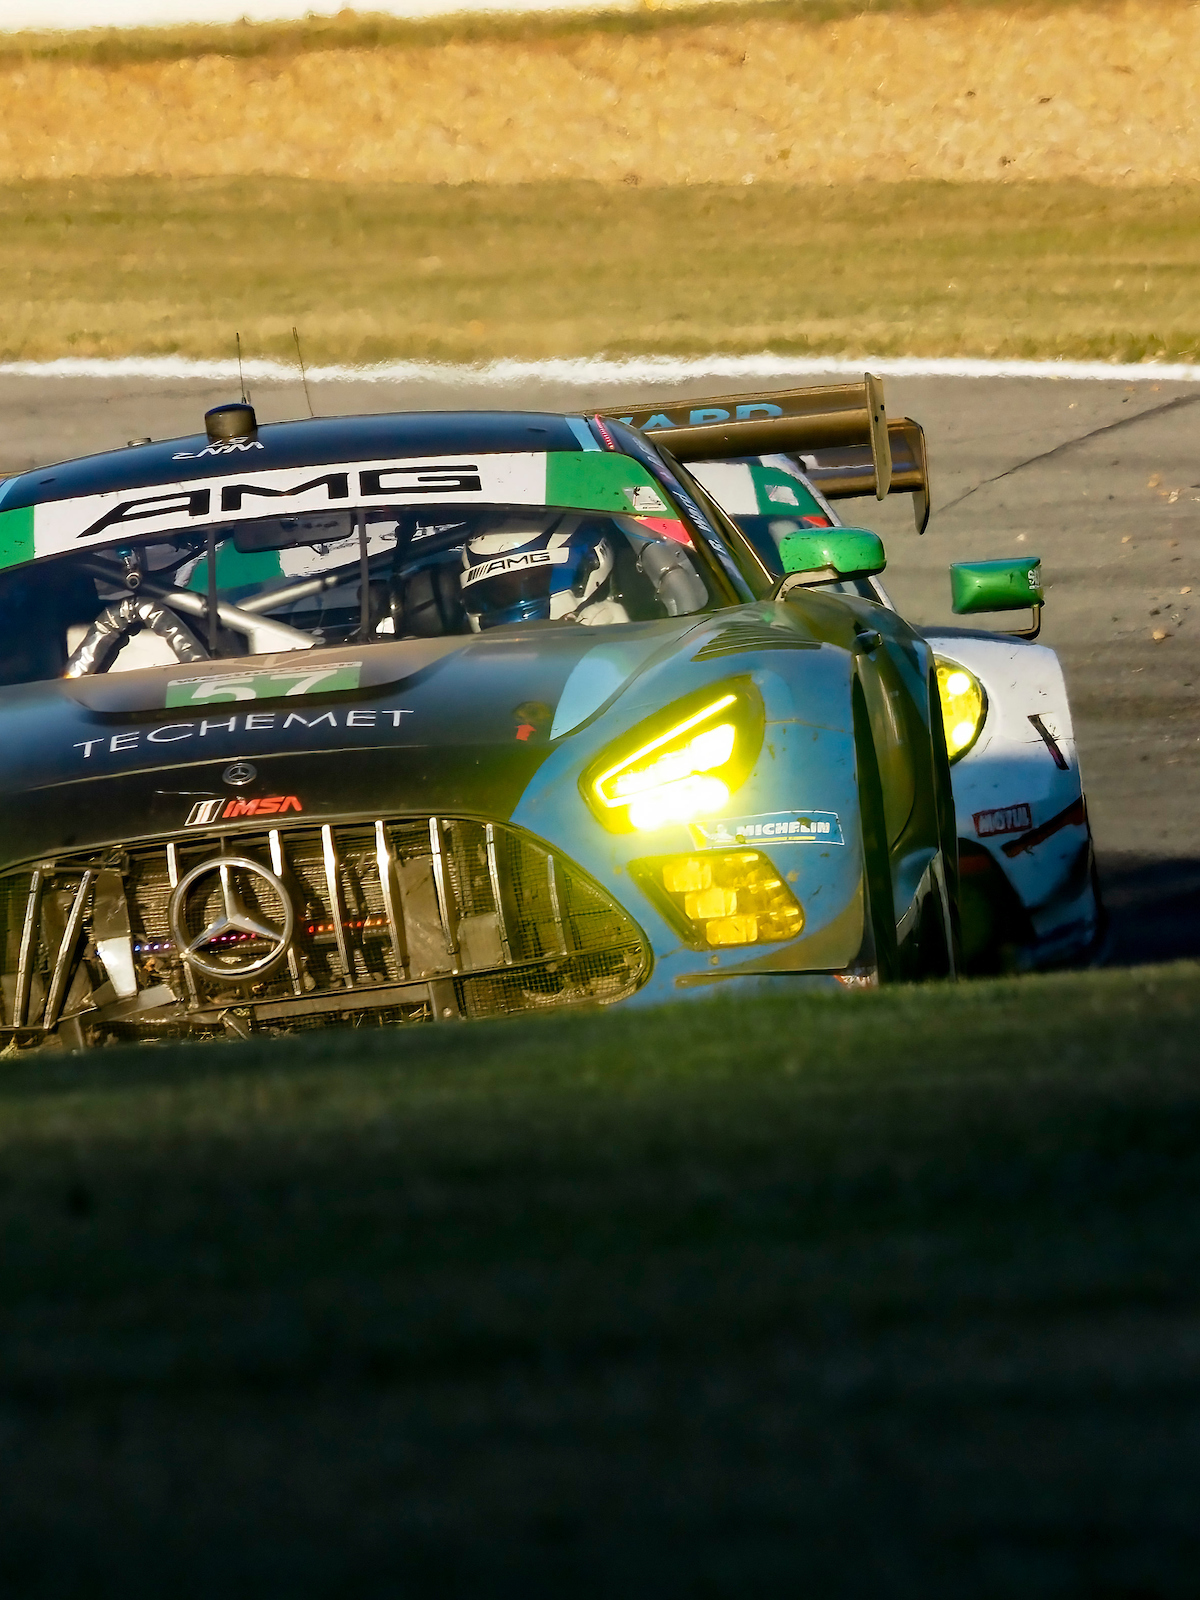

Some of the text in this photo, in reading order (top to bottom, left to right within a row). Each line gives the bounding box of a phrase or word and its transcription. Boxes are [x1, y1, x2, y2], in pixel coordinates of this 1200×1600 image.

[76, 464, 483, 539] AMG
[486, 551, 551, 574] AMG
[72, 710, 415, 759] TECHEMET
[221, 795, 303, 819] IMSA
[735, 821, 831, 838] MICHELIN
